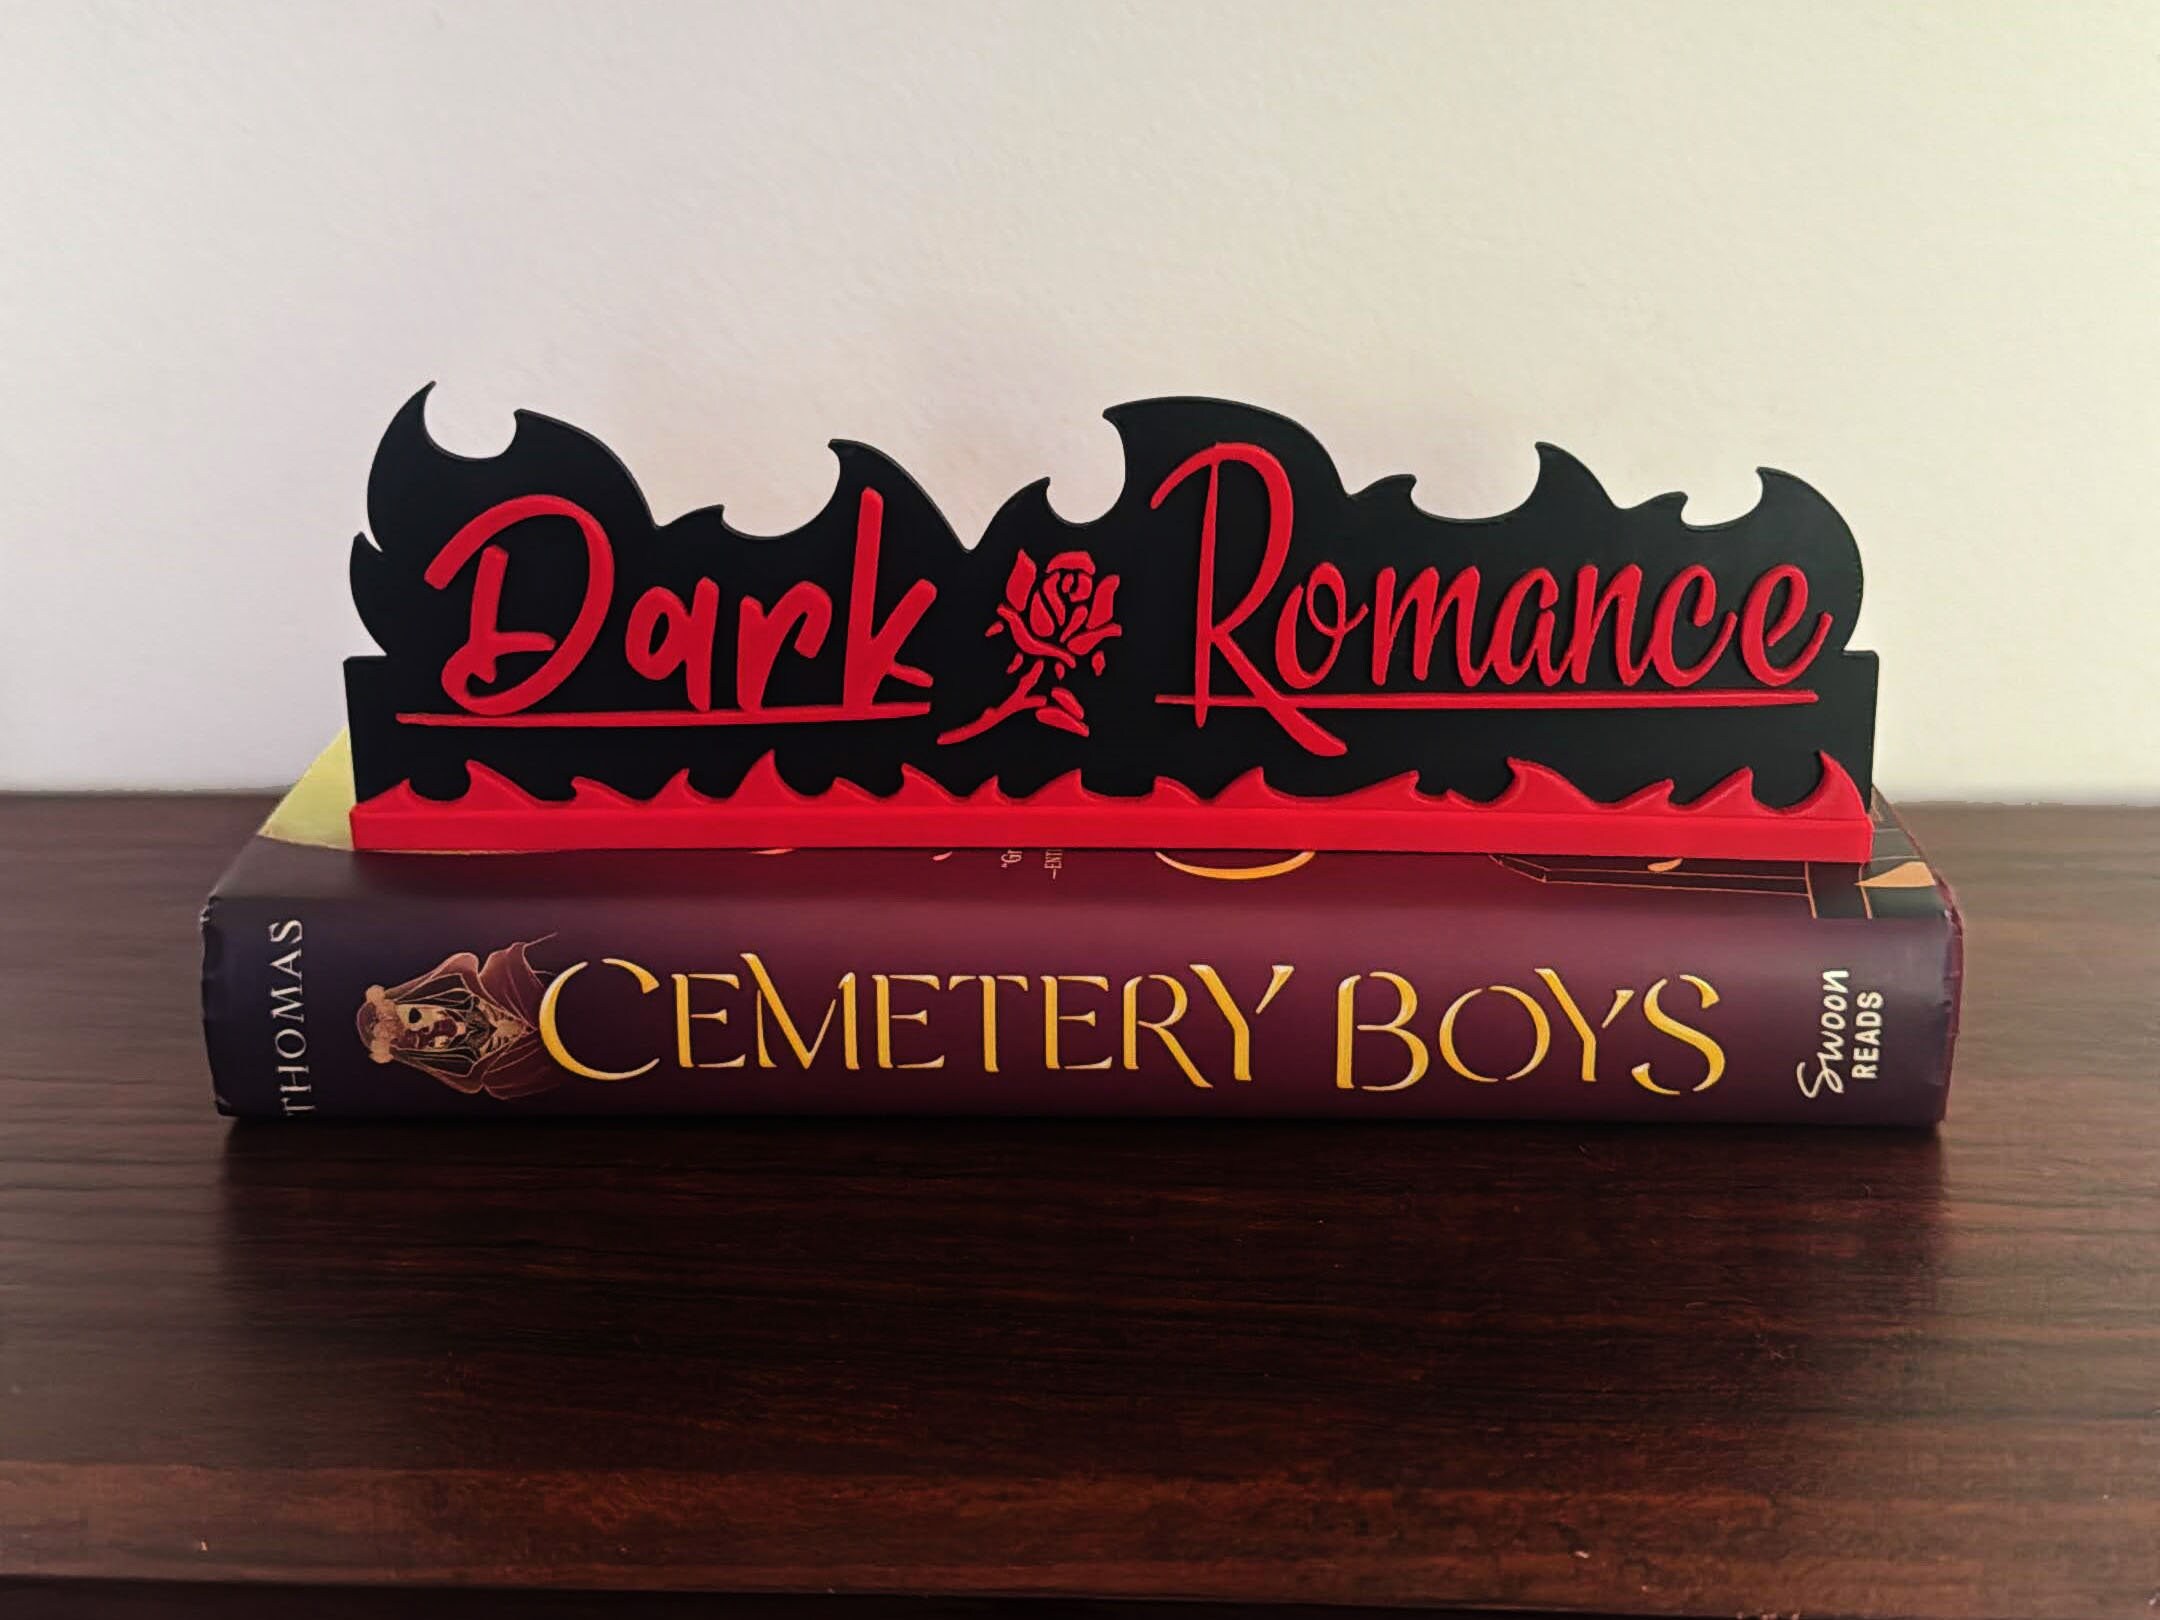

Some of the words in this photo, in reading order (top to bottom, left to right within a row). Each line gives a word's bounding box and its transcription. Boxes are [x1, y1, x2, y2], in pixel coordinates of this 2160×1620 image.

[424, 487, 938, 715] Dark
[1150, 441, 1832, 757] Romance
[268, 918, 316, 1117] THOMAS
[539, 952, 1295, 1089] CEMETERY
[1335, 967, 1726, 1095] BOYS
[1797, 970, 1849, 1099] Swoon
[1851, 991, 1884, 1079] READS
